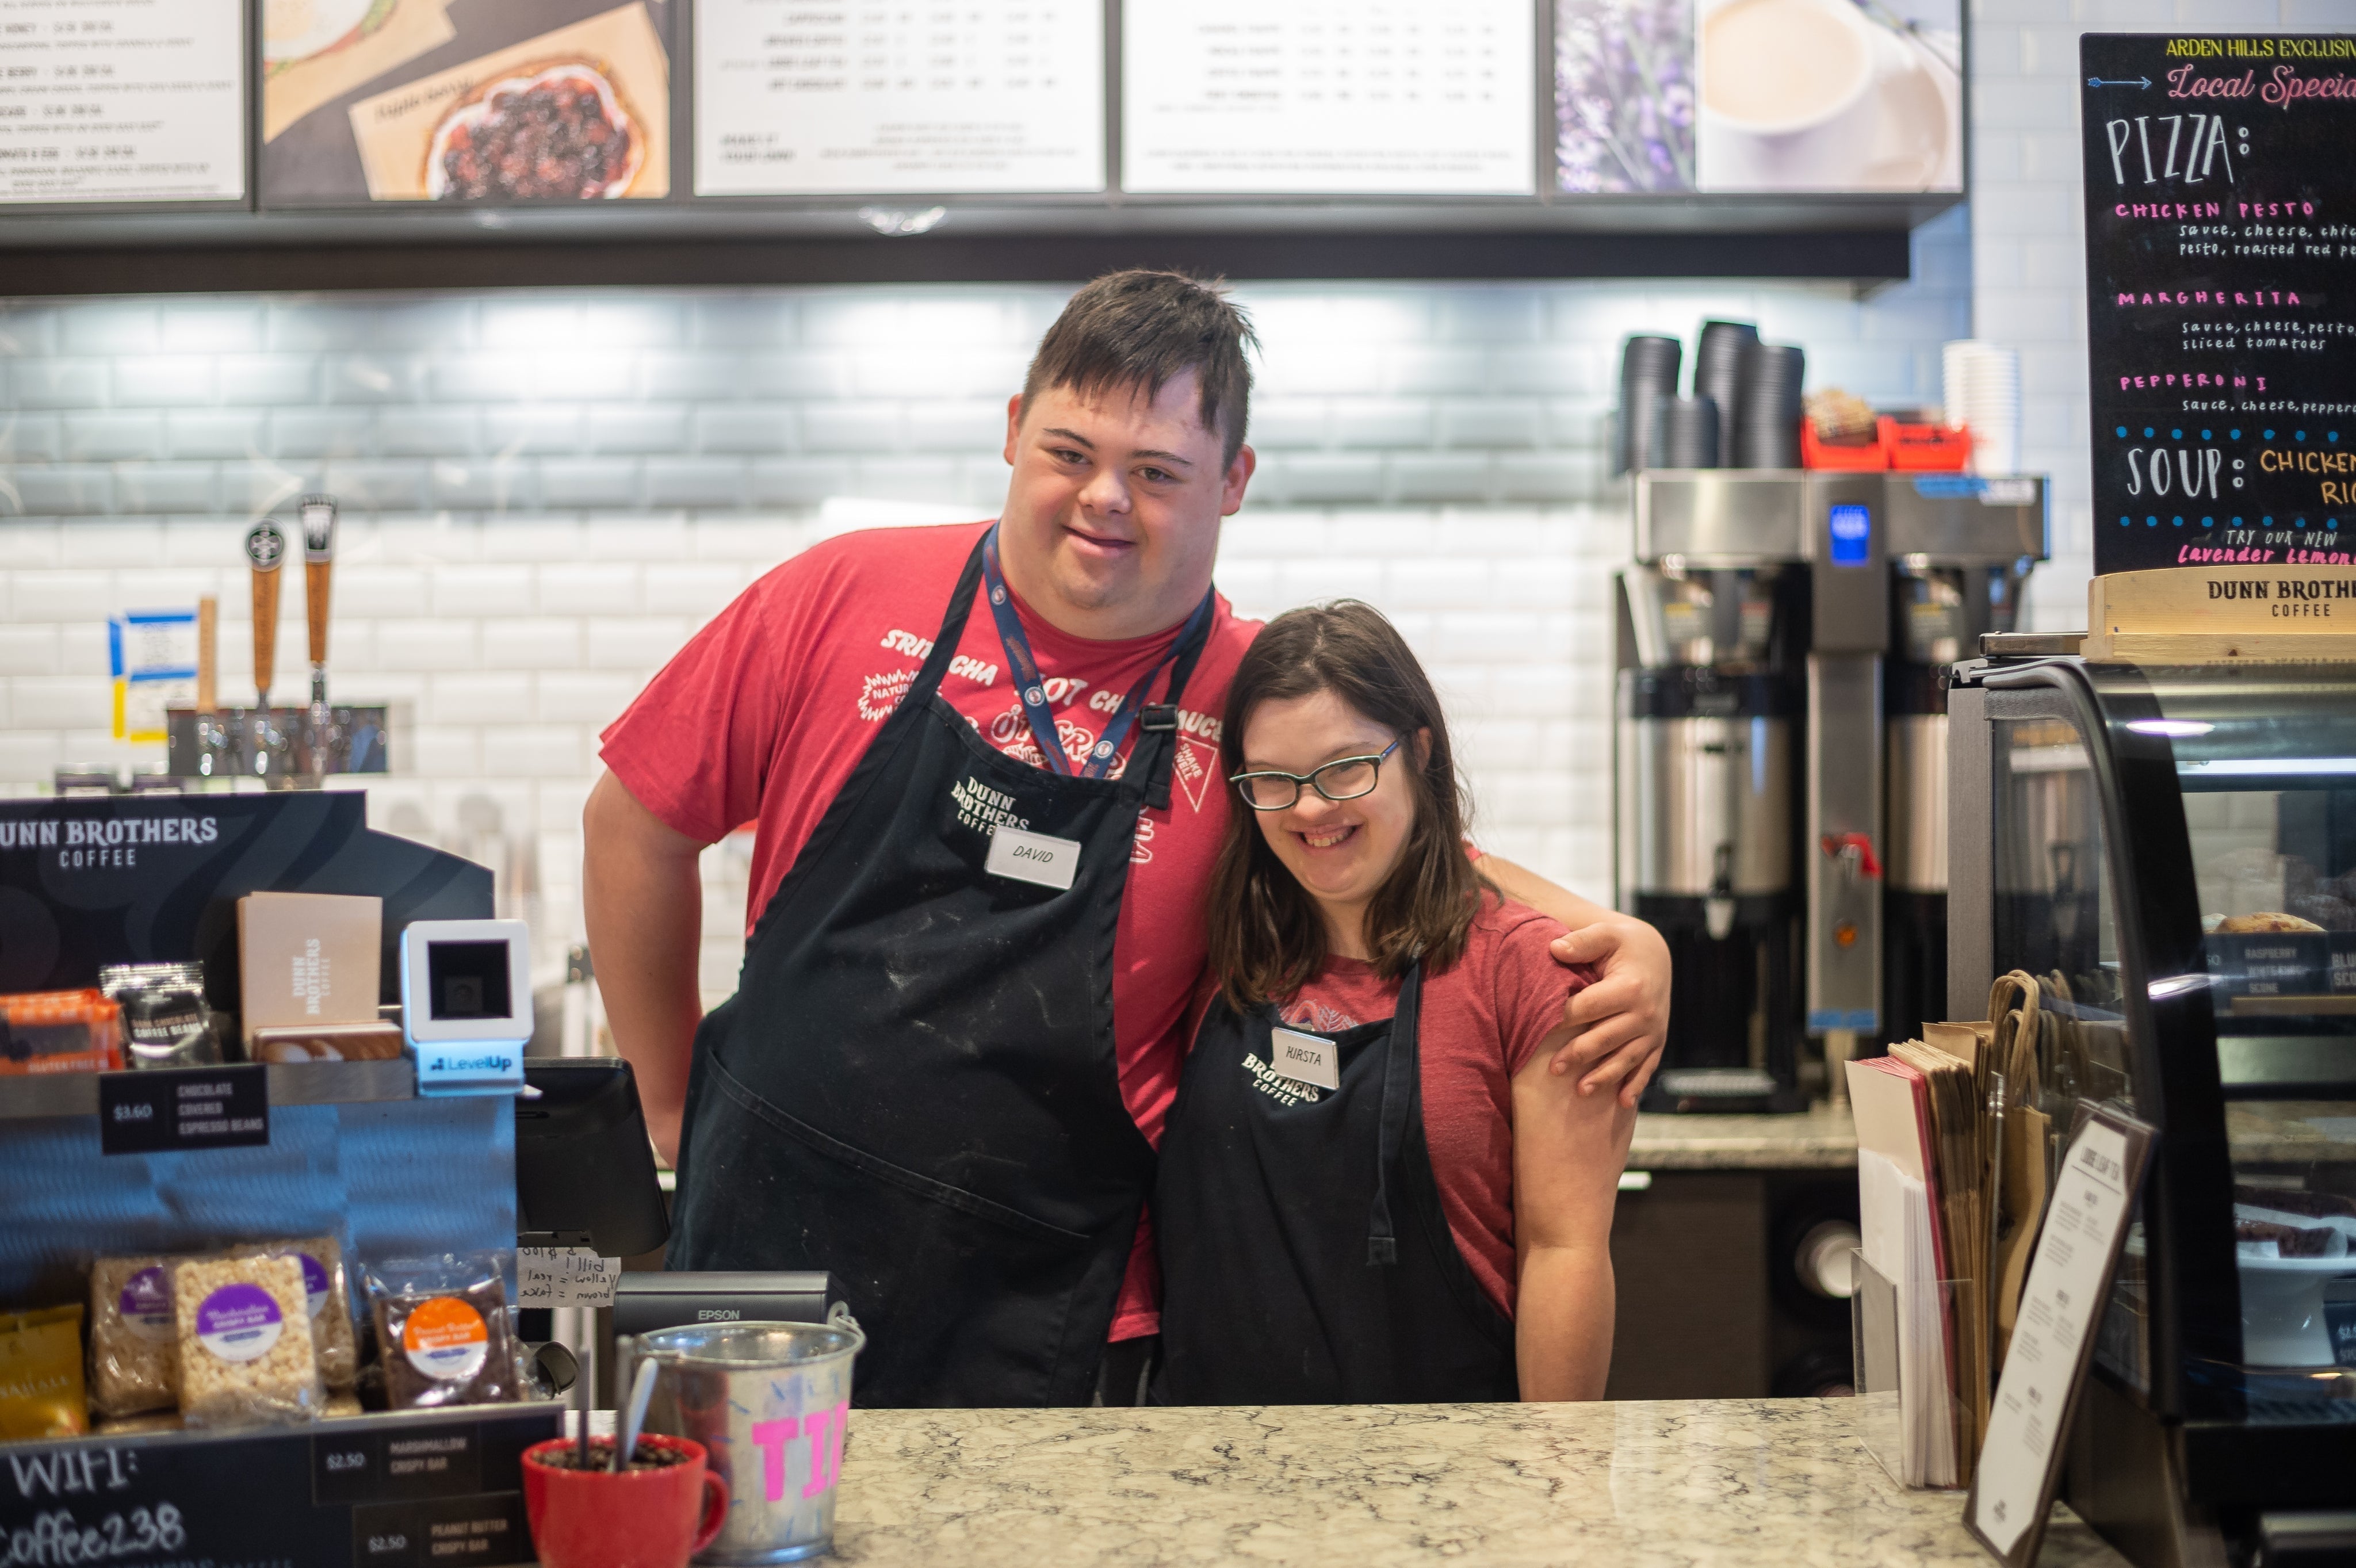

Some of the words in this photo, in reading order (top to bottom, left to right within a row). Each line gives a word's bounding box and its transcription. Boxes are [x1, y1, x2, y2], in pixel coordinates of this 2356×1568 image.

[2166, 39, 2222, 57] ARDEN
[2228, 39, 2274, 57] HILLS
[2167, 63, 2255, 98] Local
[2106, 114, 2249, 185] PIZZA:
[2116, 202, 2220, 217] CHICKEN
[2240, 201, 2315, 217] PESTO
[2179, 225, 2236, 237] sauce,
[2245, 224, 2312, 238] cheese,
[2180, 243, 2225, 256] pesto,
[2234, 243, 2295, 255] roasted
[2305, 244, 2331, 255] red
[2118, 291, 2300, 305] MARGHERITA
[2183, 323, 2240, 334] sauce,
[2183, 337, 2236, 350] sliced
[2246, 337, 2326, 350] tomatoes
[2120, 373, 2267, 392] PEPPERONI
[2183, 400, 2235, 411] sauce,
[2127, 448, 2244, 499] SOUP:
[2226, 530, 2255, 545] TRY
[2265, 530, 2293, 546] OUR
[2304, 530, 2338, 547] NEW
[2178, 545, 2275, 564] Lavender
[2207, 580, 2270, 599] DUNN
[2272, 604, 2330, 617] COFFEE
[967, 776, 1016, 811] DUNN
[951, 781, 1030, 831] BROTHERS
[64, 817, 218, 846] BROTHERS
[957, 809, 995, 836] COFFE
[59, 848, 136, 868] COFFEE
[1013, 846, 1054, 863] DAVID
[307, 938, 321, 1015] BROTHERS
[447, 1055, 512, 1072] LevelUp
[1241, 1053, 1319, 1103] BROTHERS
[1252, 1079, 1298, 1107] COFFEE
[114, 1103, 152, 1121] $3.60
[698, 1310, 740, 1320] EPSON
[327, 1451, 365, 1470] $2.50
[0, 1501, 186, 1566] offee238
[368, 1534, 407, 1553] $2.50
